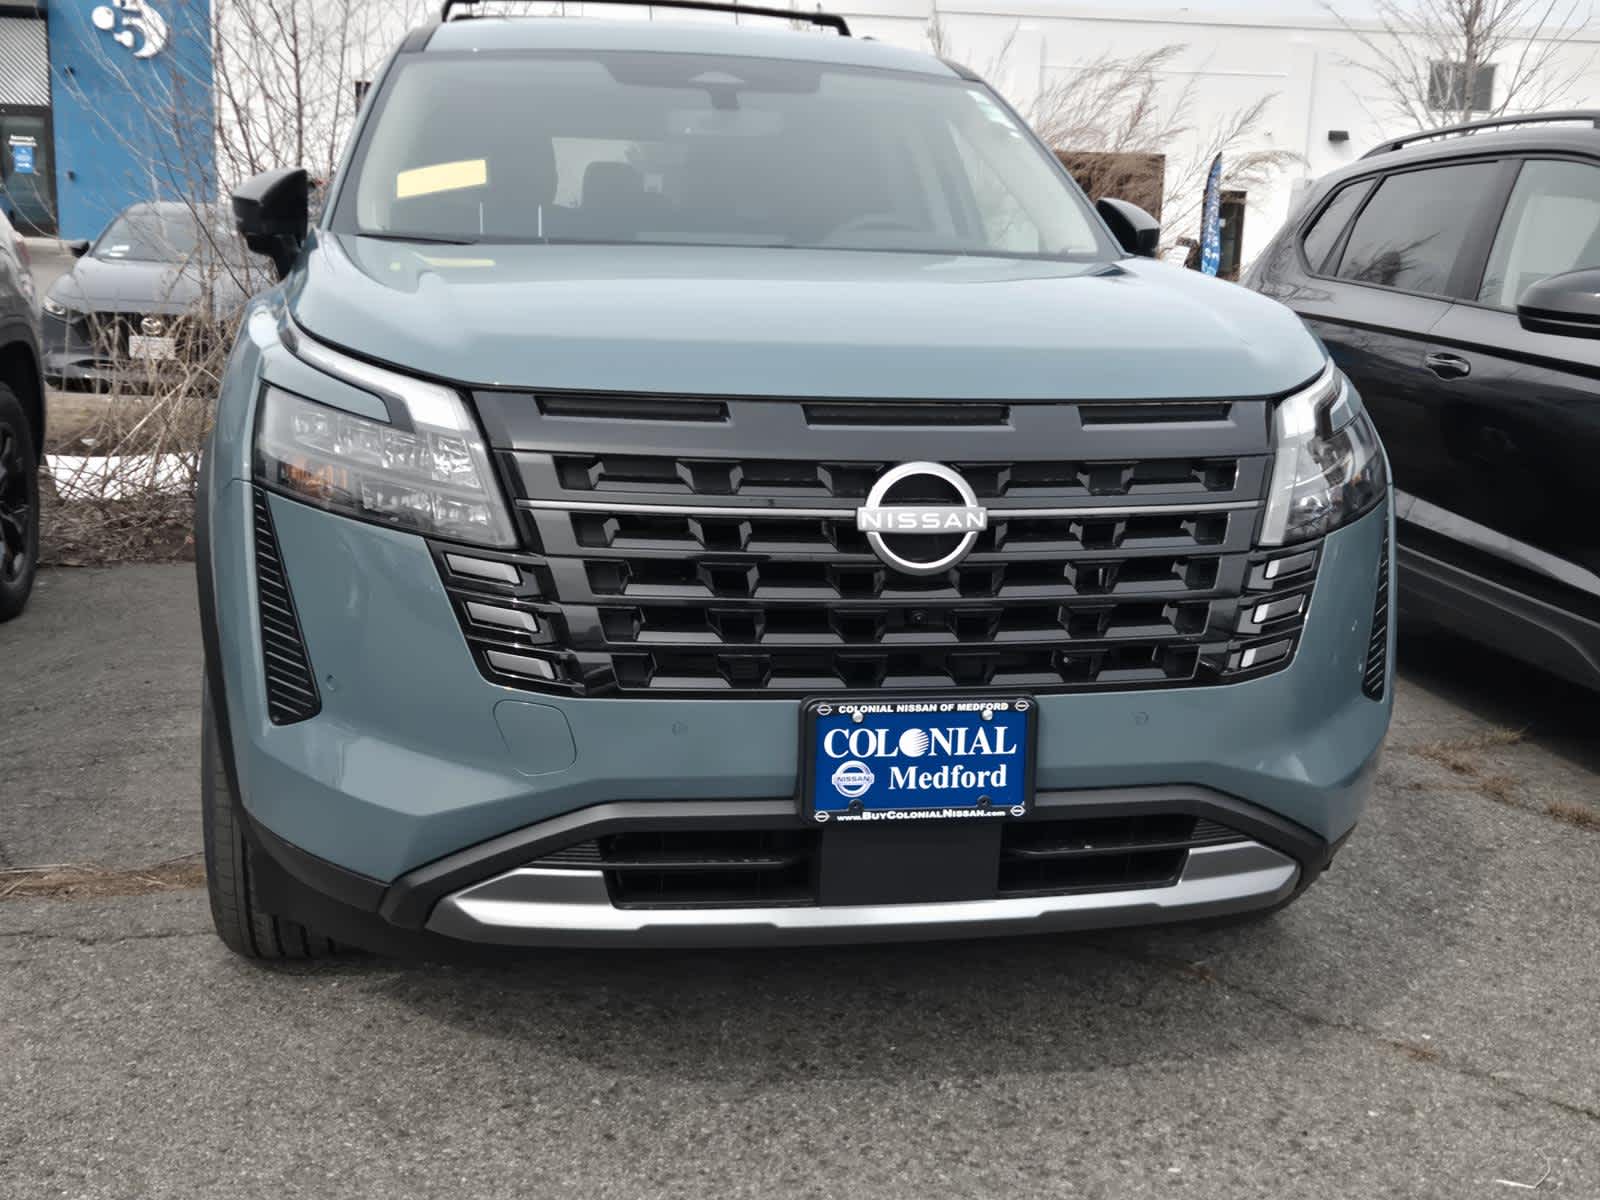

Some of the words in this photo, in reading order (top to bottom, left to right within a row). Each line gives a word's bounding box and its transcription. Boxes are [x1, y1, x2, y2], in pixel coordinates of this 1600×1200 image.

[861, 511, 984, 529] NISSAN
[838, 704, 894, 714] COLONIAL
[896, 703, 940, 713] NISSAN
[940, 702, 955, 712] OF
[956, 702, 1009, 712] MEDFORD
[823, 726, 1017, 759] COLONIAL
[888, 764, 1008, 790] Medford
